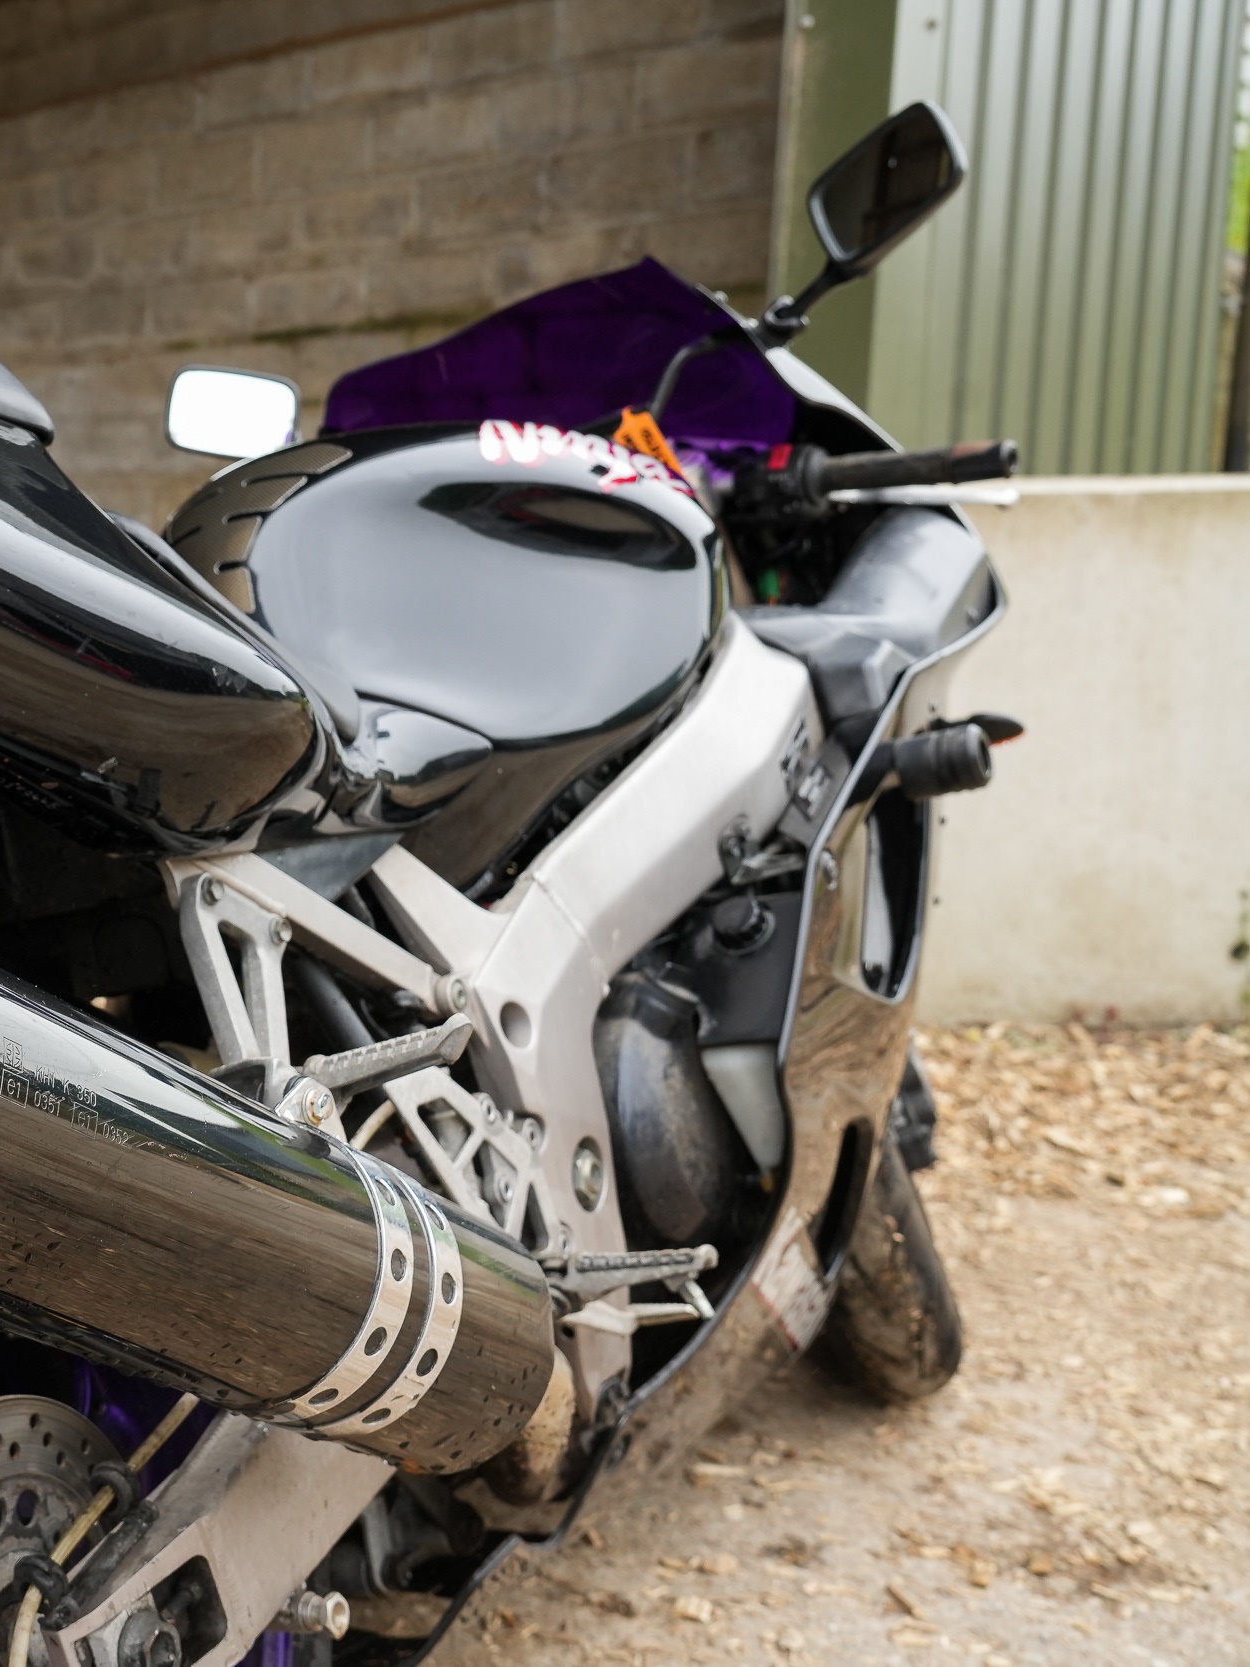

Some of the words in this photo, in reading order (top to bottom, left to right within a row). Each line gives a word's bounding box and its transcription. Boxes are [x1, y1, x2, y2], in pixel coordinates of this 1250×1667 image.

[7, 1078, 21, 1099] e1
[33, 1090, 61, 1117] 0351
[102, 1122, 129, 1148] 0352
[61, 1077, 71, 1096] K
[76, 1084, 97, 1108] 350
